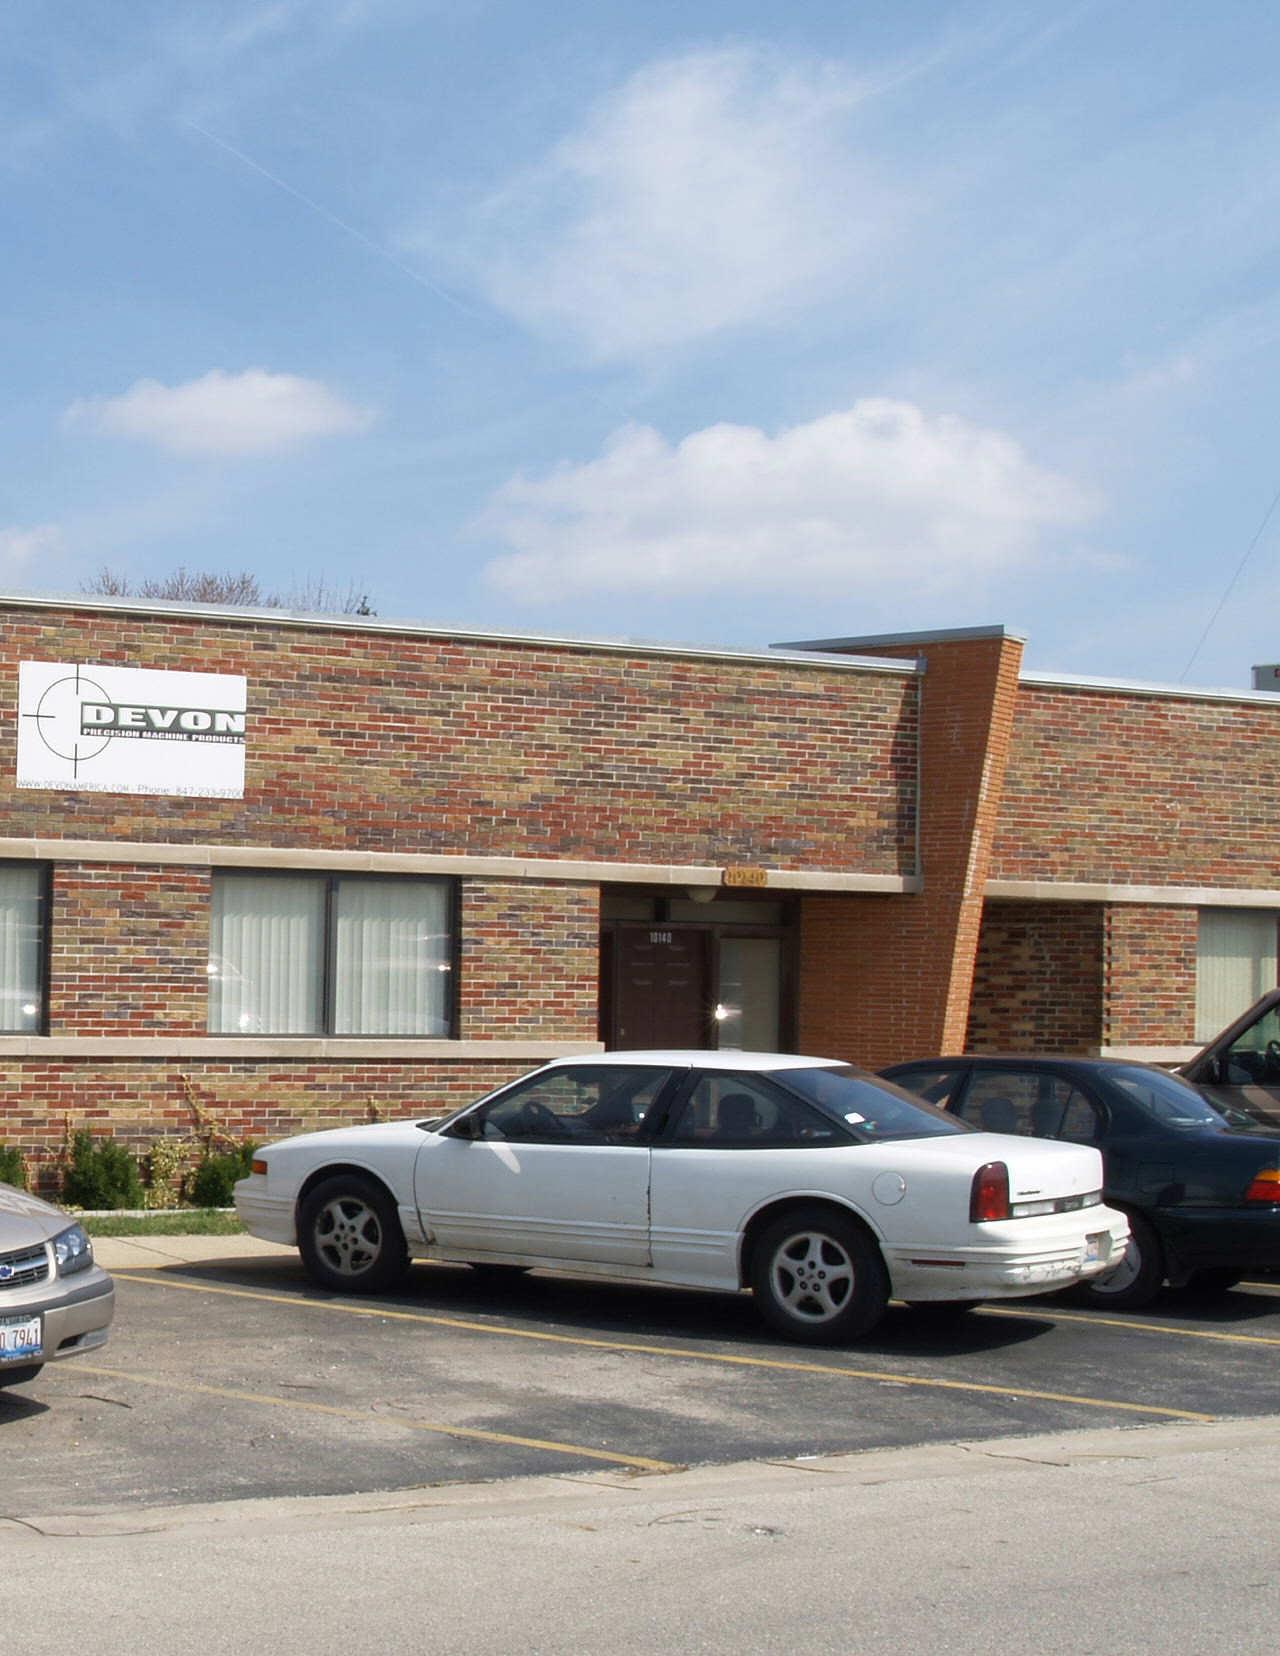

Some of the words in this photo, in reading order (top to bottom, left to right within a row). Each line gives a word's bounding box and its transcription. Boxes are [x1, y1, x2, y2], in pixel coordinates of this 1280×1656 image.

[82, 704, 245, 733] DEVON
[83, 728, 140, 738] PRECISION
[142, 731, 189, 742] MACHINE
[191, 734, 246, 745] PRODUCTS
[12, 1328, 40, 1350] 7941
